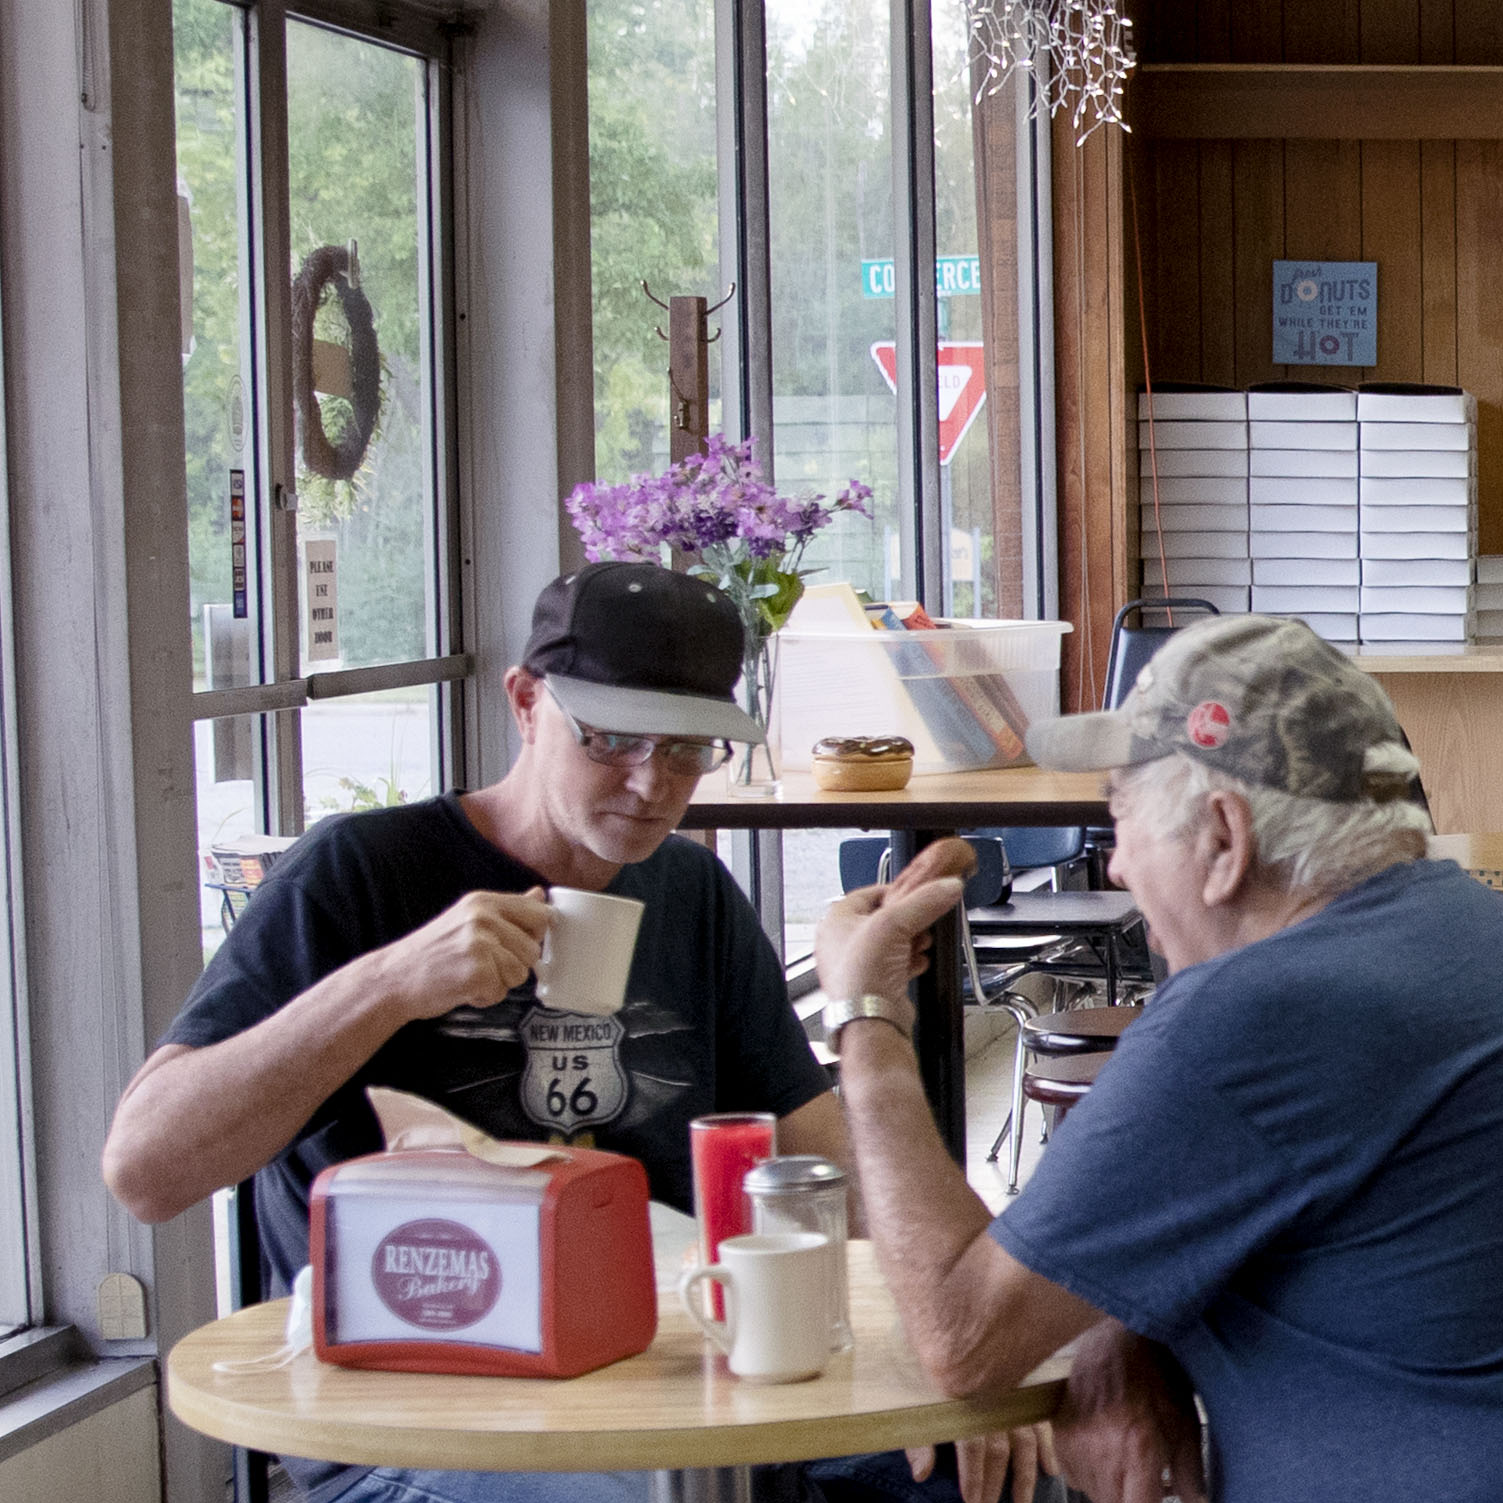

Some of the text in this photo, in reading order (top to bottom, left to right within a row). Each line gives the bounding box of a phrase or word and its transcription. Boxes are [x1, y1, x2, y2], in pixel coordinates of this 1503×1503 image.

[1281, 279, 1370, 304] DONUTS
[1320, 304, 1341, 316] GET
[1279, 317, 1313, 328] WHILE
[1293, 330, 1360, 361] HOT
[309, 561, 334, 574] PLEASE
[315, 584, 328, 597] USE
[312, 607, 334, 620] OTHER
[314, 631, 333, 644] DOOR
[530, 1023, 611, 1042] NEW MEXICO
[547, 1077, 598, 1117] 66
[384, 1245, 490, 1280] RENZEMAS
